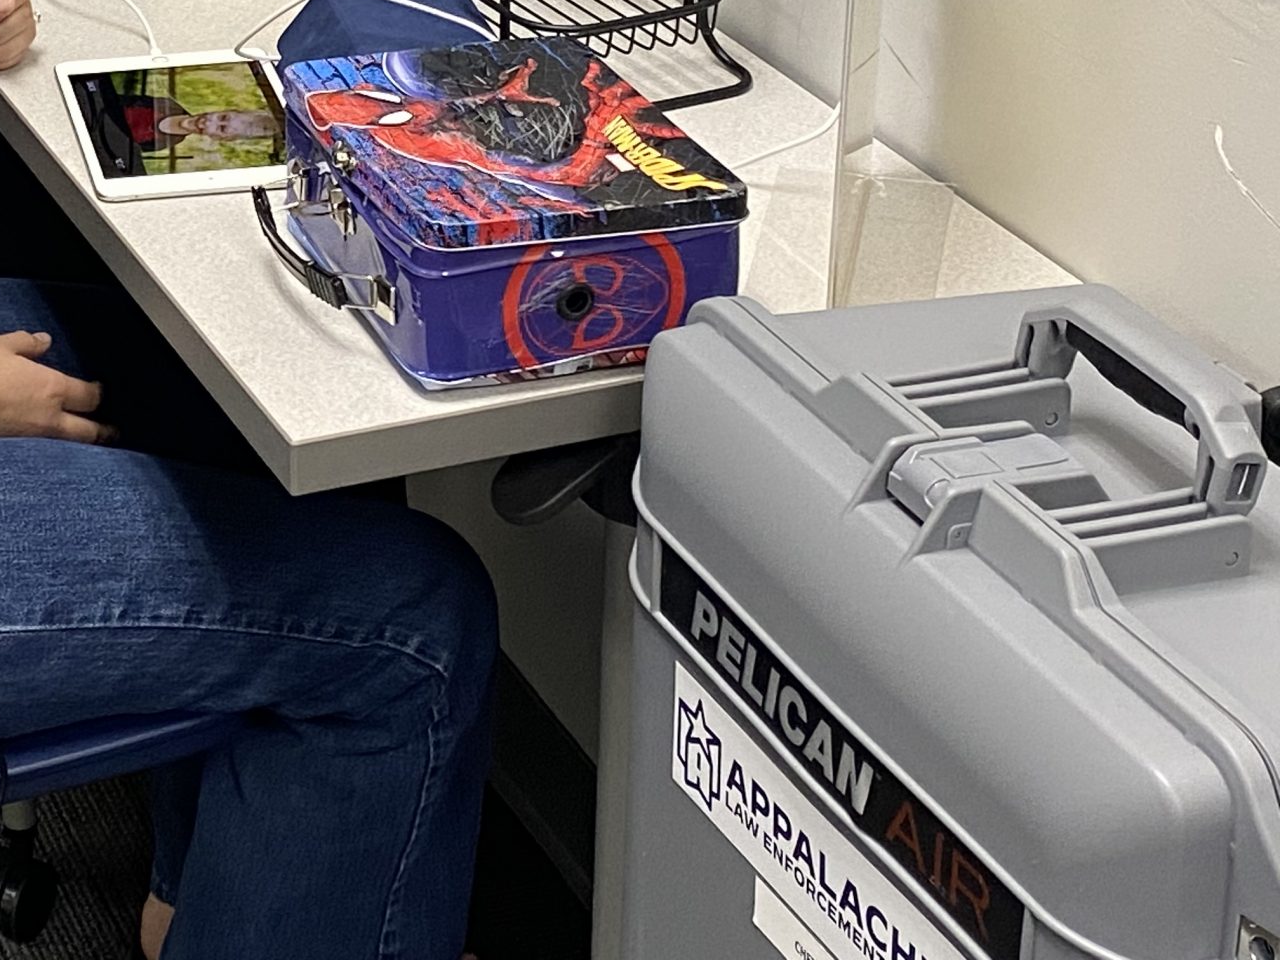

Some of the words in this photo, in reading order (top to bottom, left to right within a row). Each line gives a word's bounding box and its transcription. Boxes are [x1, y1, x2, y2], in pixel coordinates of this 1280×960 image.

[690, 590, 874, 816] PELICAN
[884, 800, 990, 940] AIR
[725, 790, 760, 839] LAW
[726, 759, 927, 960] APPALACH
